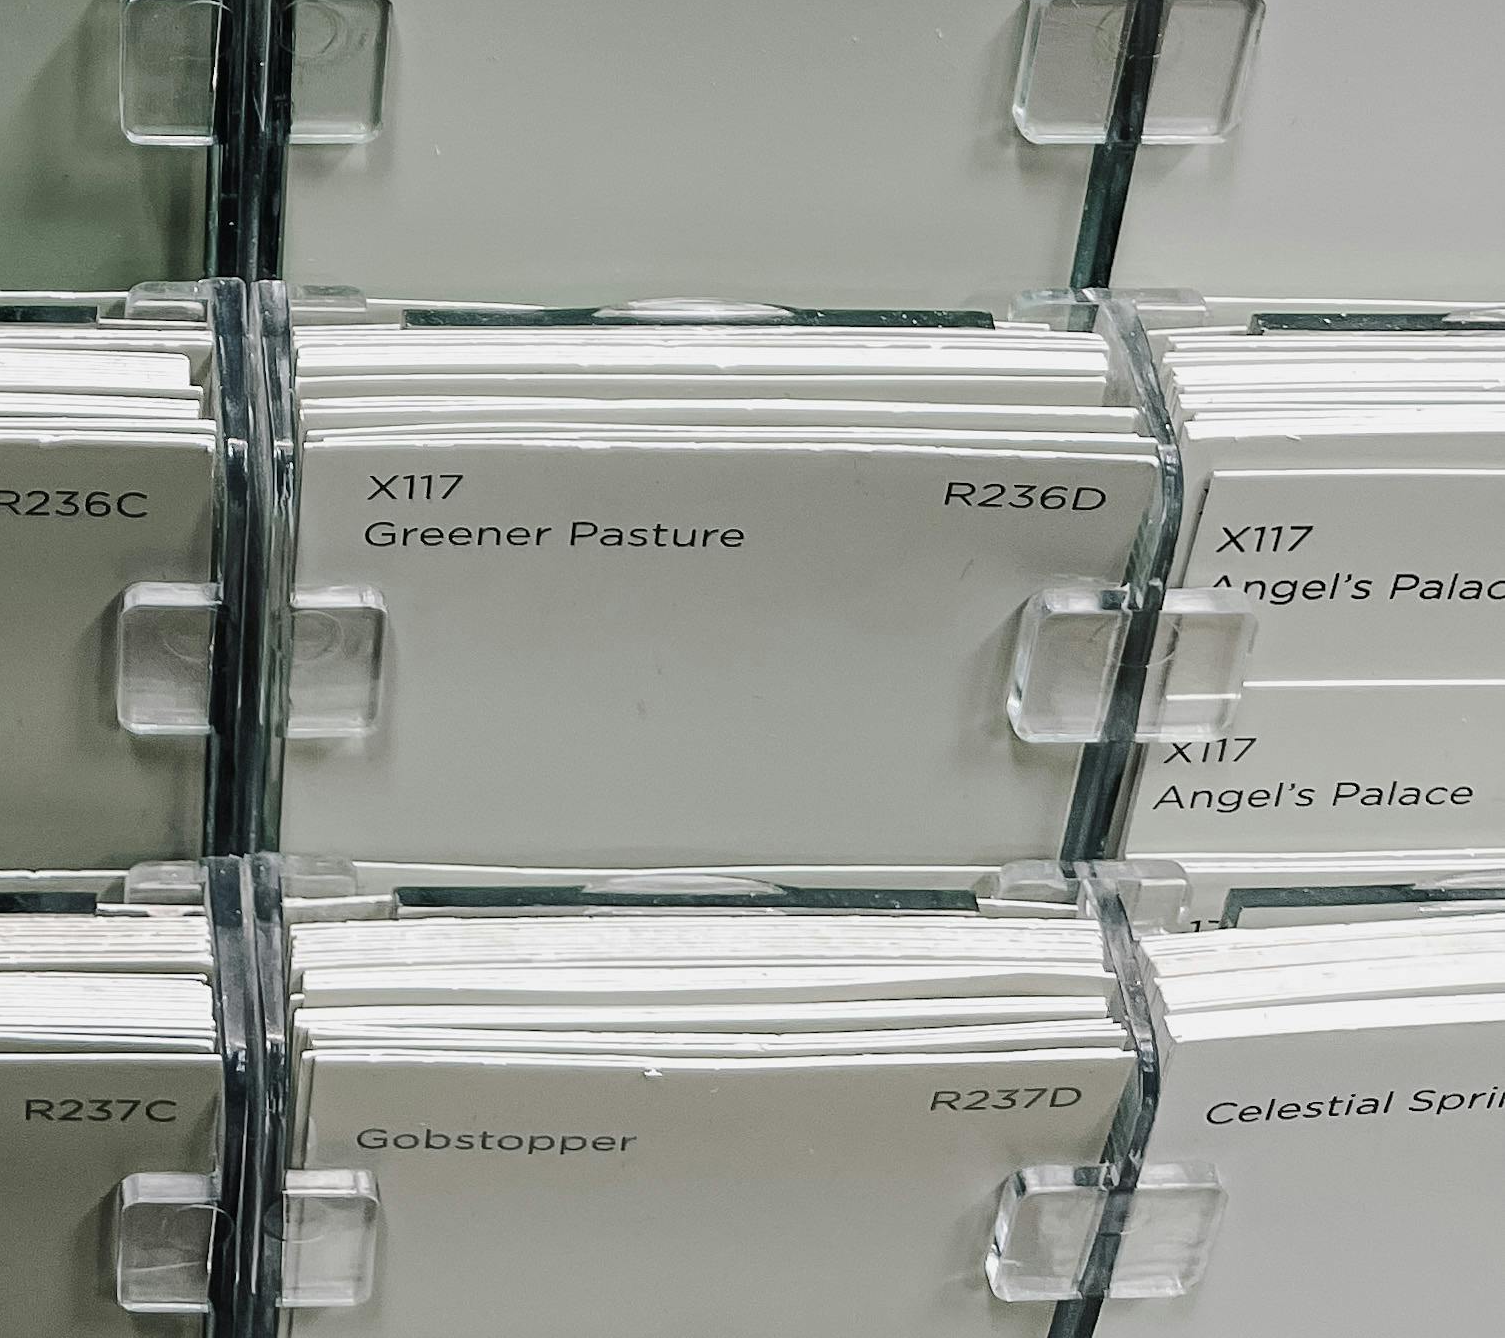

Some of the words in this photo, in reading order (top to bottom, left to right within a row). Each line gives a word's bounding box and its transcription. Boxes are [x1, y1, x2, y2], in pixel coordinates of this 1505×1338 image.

[368, 474, 464, 500] X117
[944, 481, 1107, 511] R236D
[364, 521, 552, 547] Greener
[569, 521, 745, 548] Pasture
[1216, 525, 1314, 553] X117
[1163, 737, 1257, 764] X117
[1153, 782, 1315, 814] Angel's
[1332, 780, 1474, 807] Palace
[25, 1099, 177, 1123] R237C
[930, 1086, 1082, 1111] R237D
[1206, 1091, 1394, 1125] Celestial
[1408, 1089, 1505, 1115] Spri
[356, 1128, 637, 1156] Gobstopper
